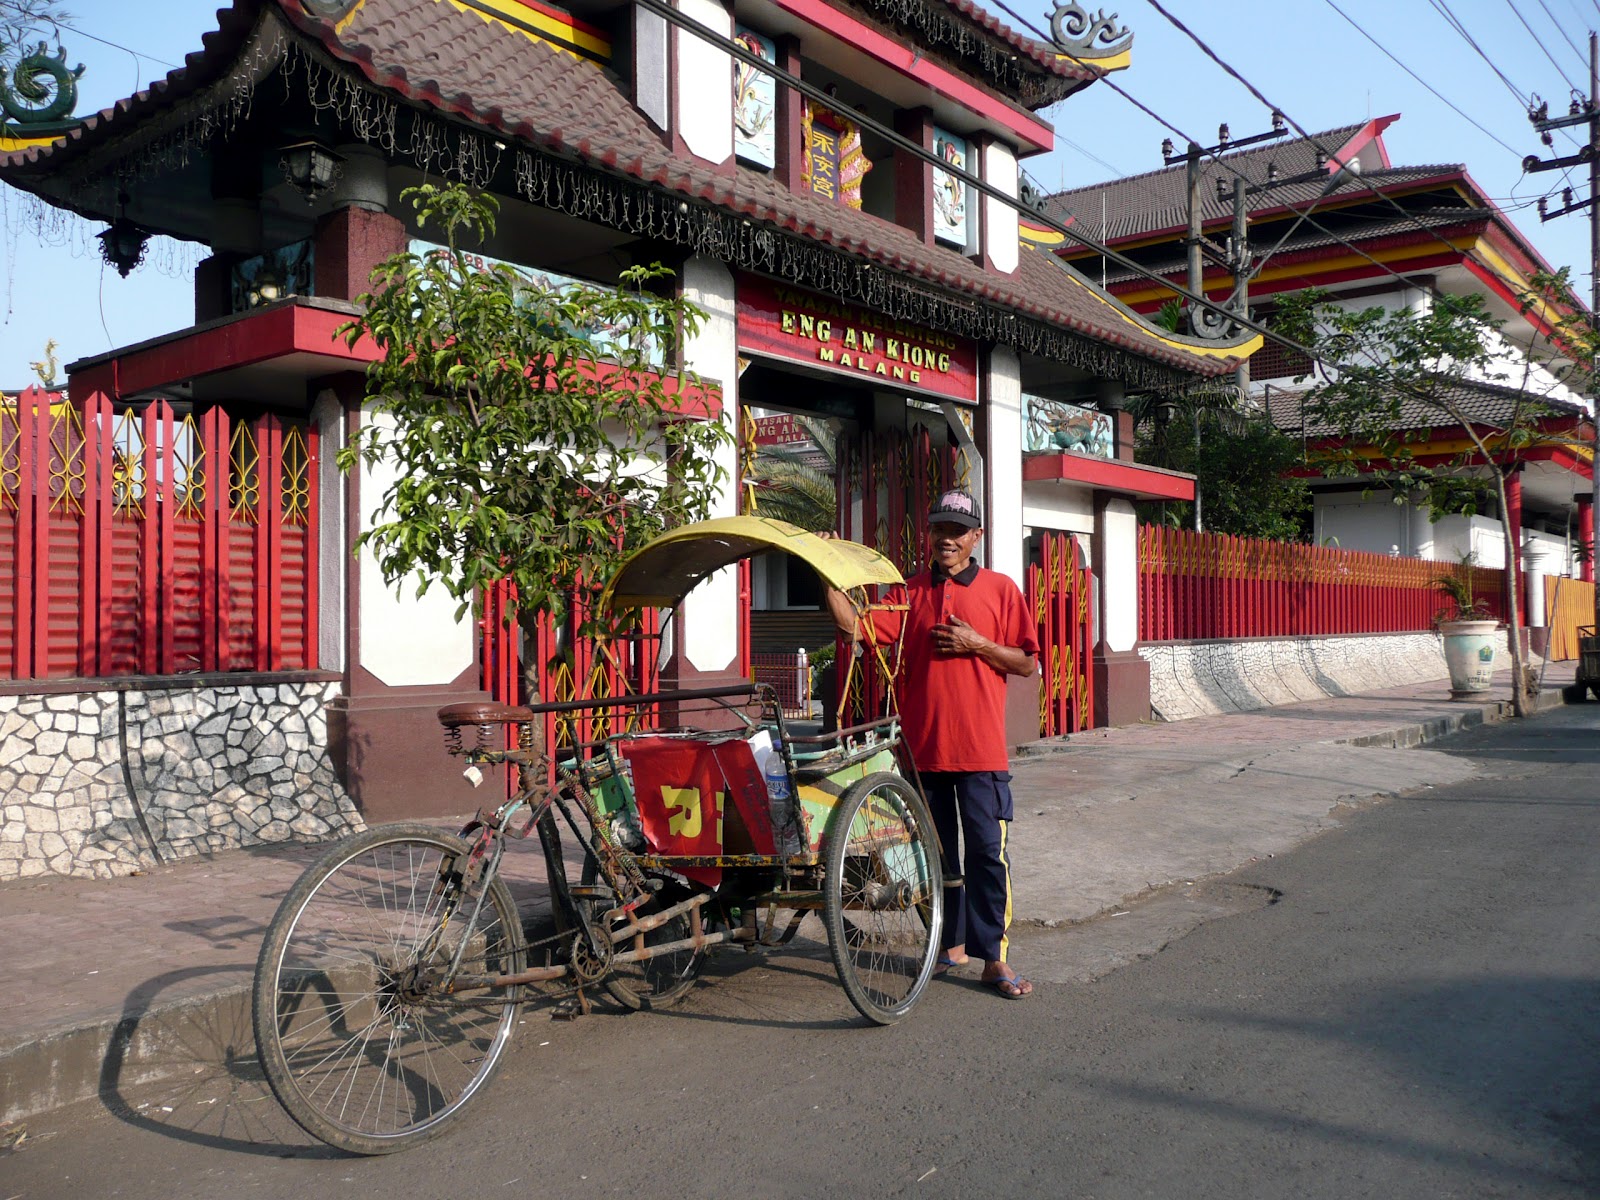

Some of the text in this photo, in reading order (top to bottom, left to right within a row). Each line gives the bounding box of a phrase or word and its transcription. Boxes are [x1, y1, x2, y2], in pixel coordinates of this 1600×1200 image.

[781, 309, 950, 373] ENG AN KIONG
[860, 310, 956, 350] KELENTENG
[819, 347, 921, 383] MALANG
[781, 423, 799, 435] AN
